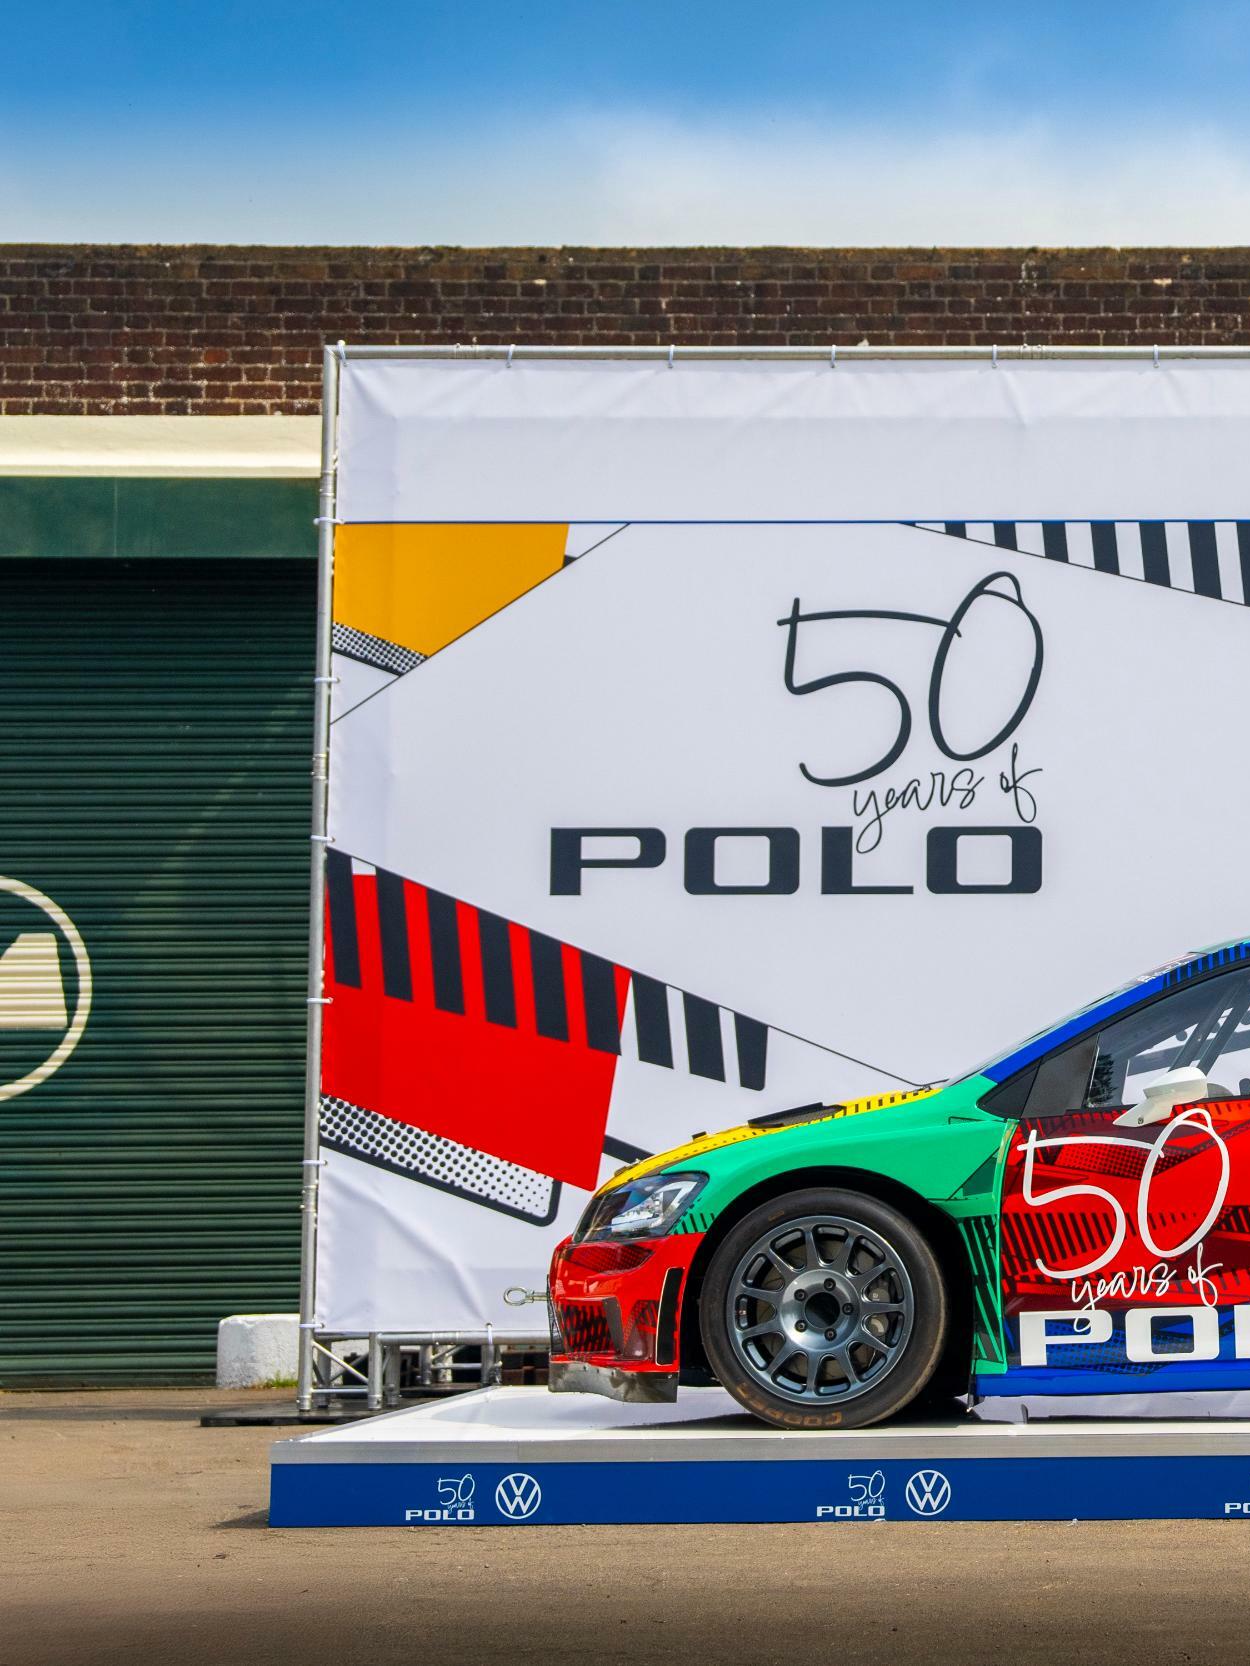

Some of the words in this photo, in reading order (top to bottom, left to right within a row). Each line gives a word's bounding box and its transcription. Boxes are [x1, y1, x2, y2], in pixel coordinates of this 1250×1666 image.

[777, 571, 1043, 787] 50
[852, 767, 985, 853] years
[1000, 742, 1043, 823] of
[549, 826, 1043, 896] POLO
[1017, 1108, 1230, 1278] 50
[1071, 1261, 1177, 1332] years
[1187, 1243, 1223, 1307] of
[405, 1509, 475, 1521] POLO
[437, 1473, 475, 1505] 50
[816, 1505, 885, 1517] POLO
[848, 1470, 885, 1501] 50
